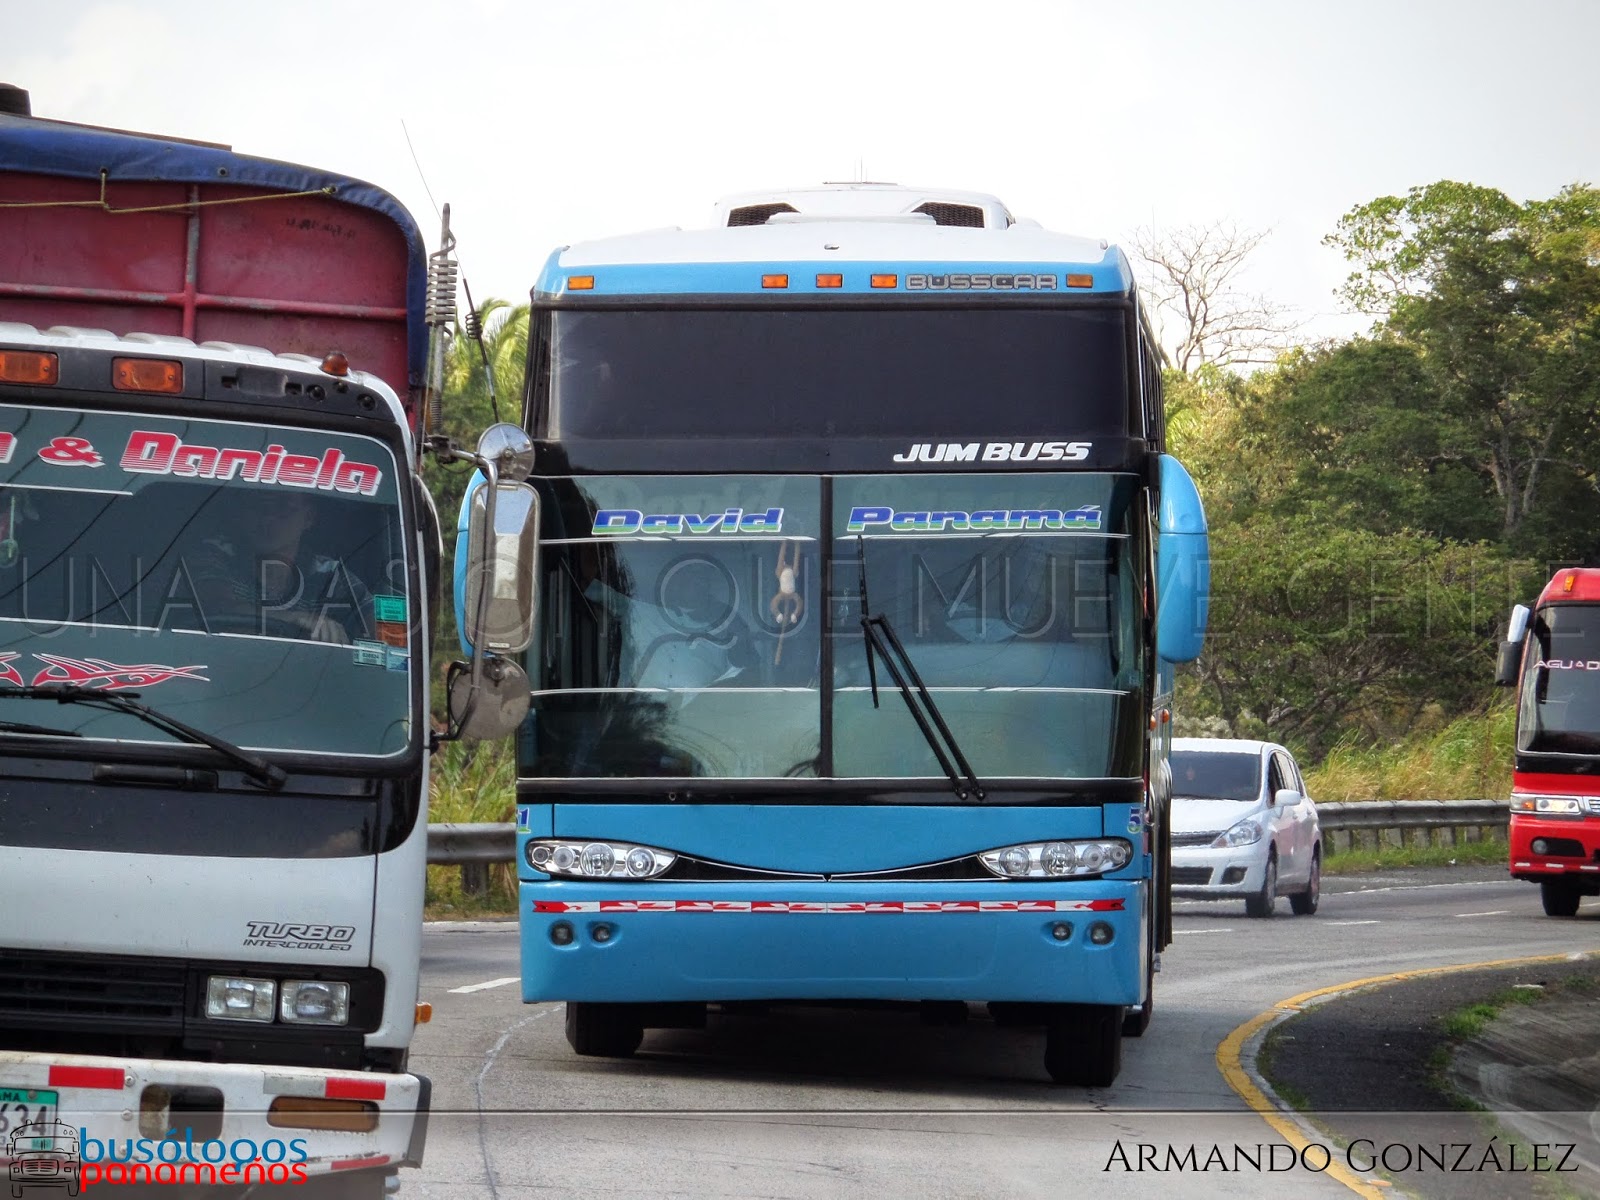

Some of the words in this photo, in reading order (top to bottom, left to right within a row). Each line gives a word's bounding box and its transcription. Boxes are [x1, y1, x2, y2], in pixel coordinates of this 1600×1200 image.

[905, 273, 1058, 291] BUSSCAR
[119, 430, 383, 497] Daniela
[592, 507, 785, 535] David
[847, 504, 1102, 533] Panamá
[246, 920, 356, 943] TURBO
[243, 938, 352, 952] INTERCOOLED
[0, 1090, 20, 1102] MA
